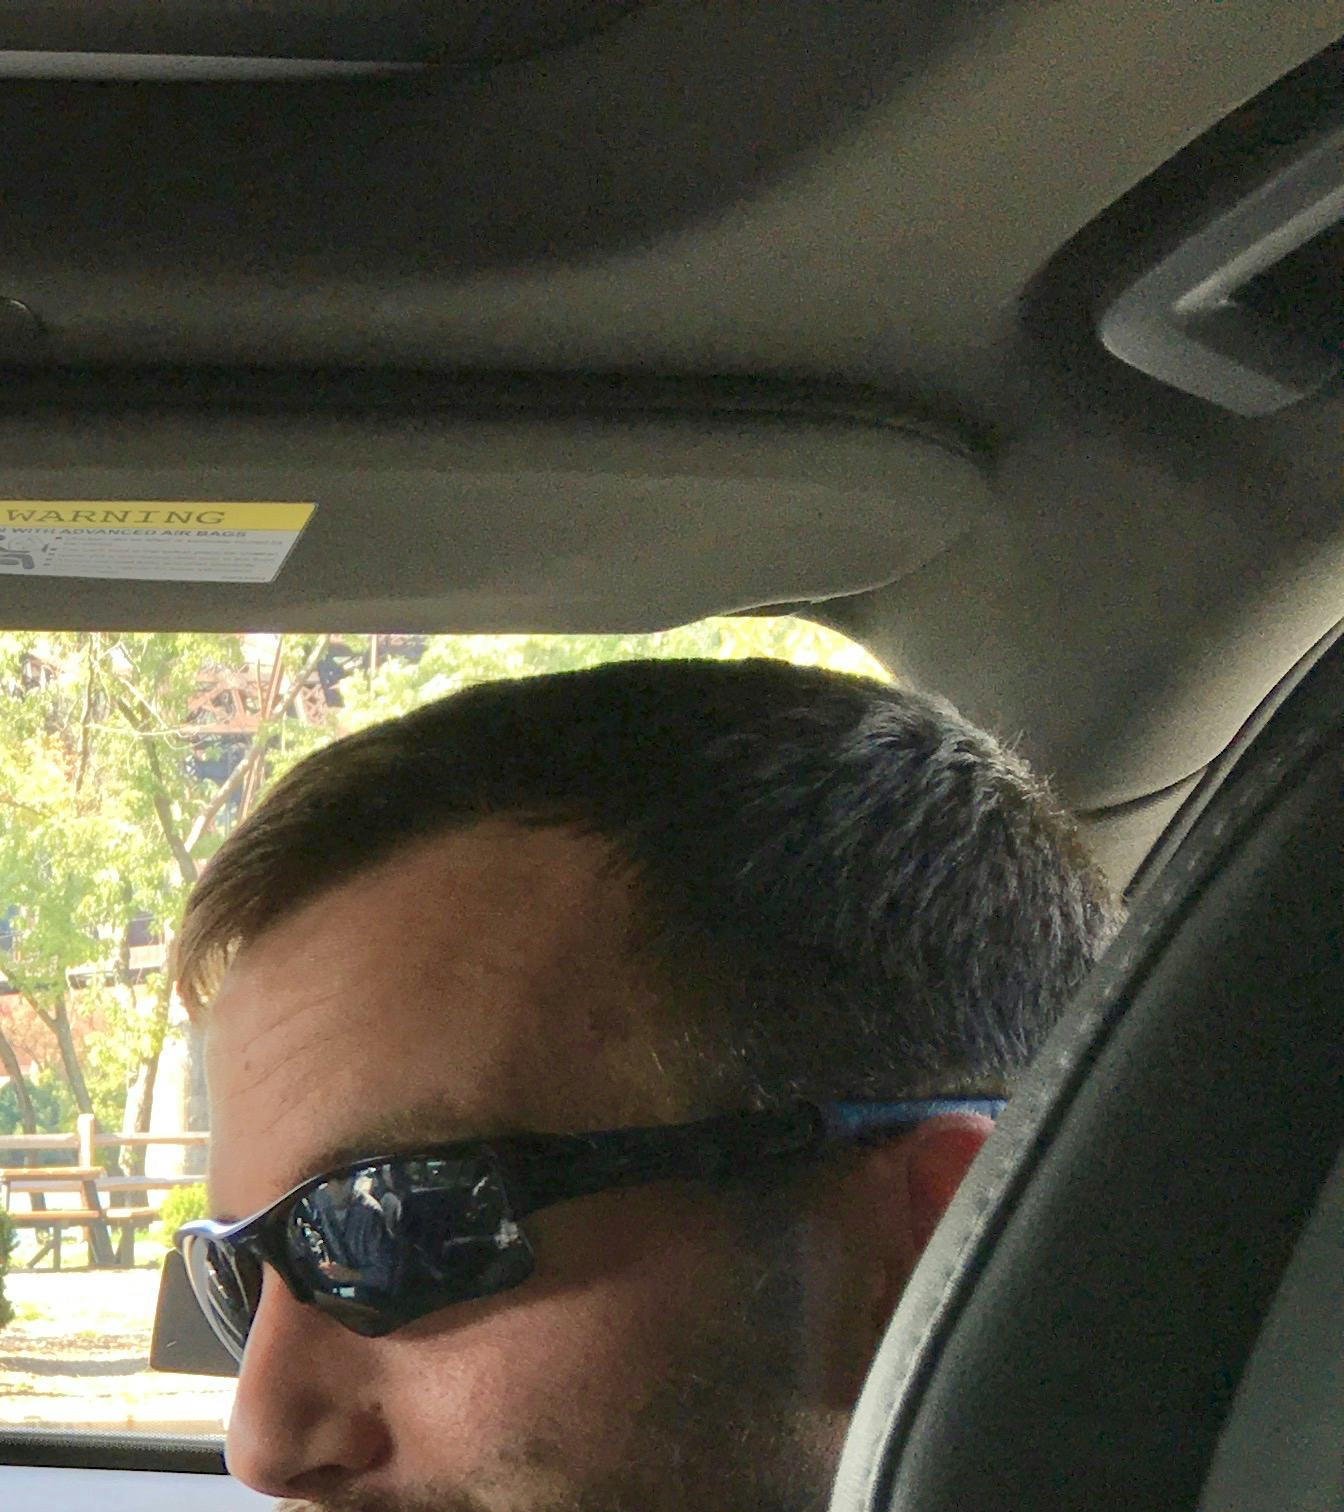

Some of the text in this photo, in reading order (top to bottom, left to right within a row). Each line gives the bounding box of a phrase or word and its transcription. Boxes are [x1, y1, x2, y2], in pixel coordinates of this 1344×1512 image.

[5, 509, 226, 526] WARNING
[11, 527, 57, 535] WITH
[61, 528, 157, 536] ADVANCED
[161, 529, 193, 537] AIR
[198, 529, 247, 538] BAGS
